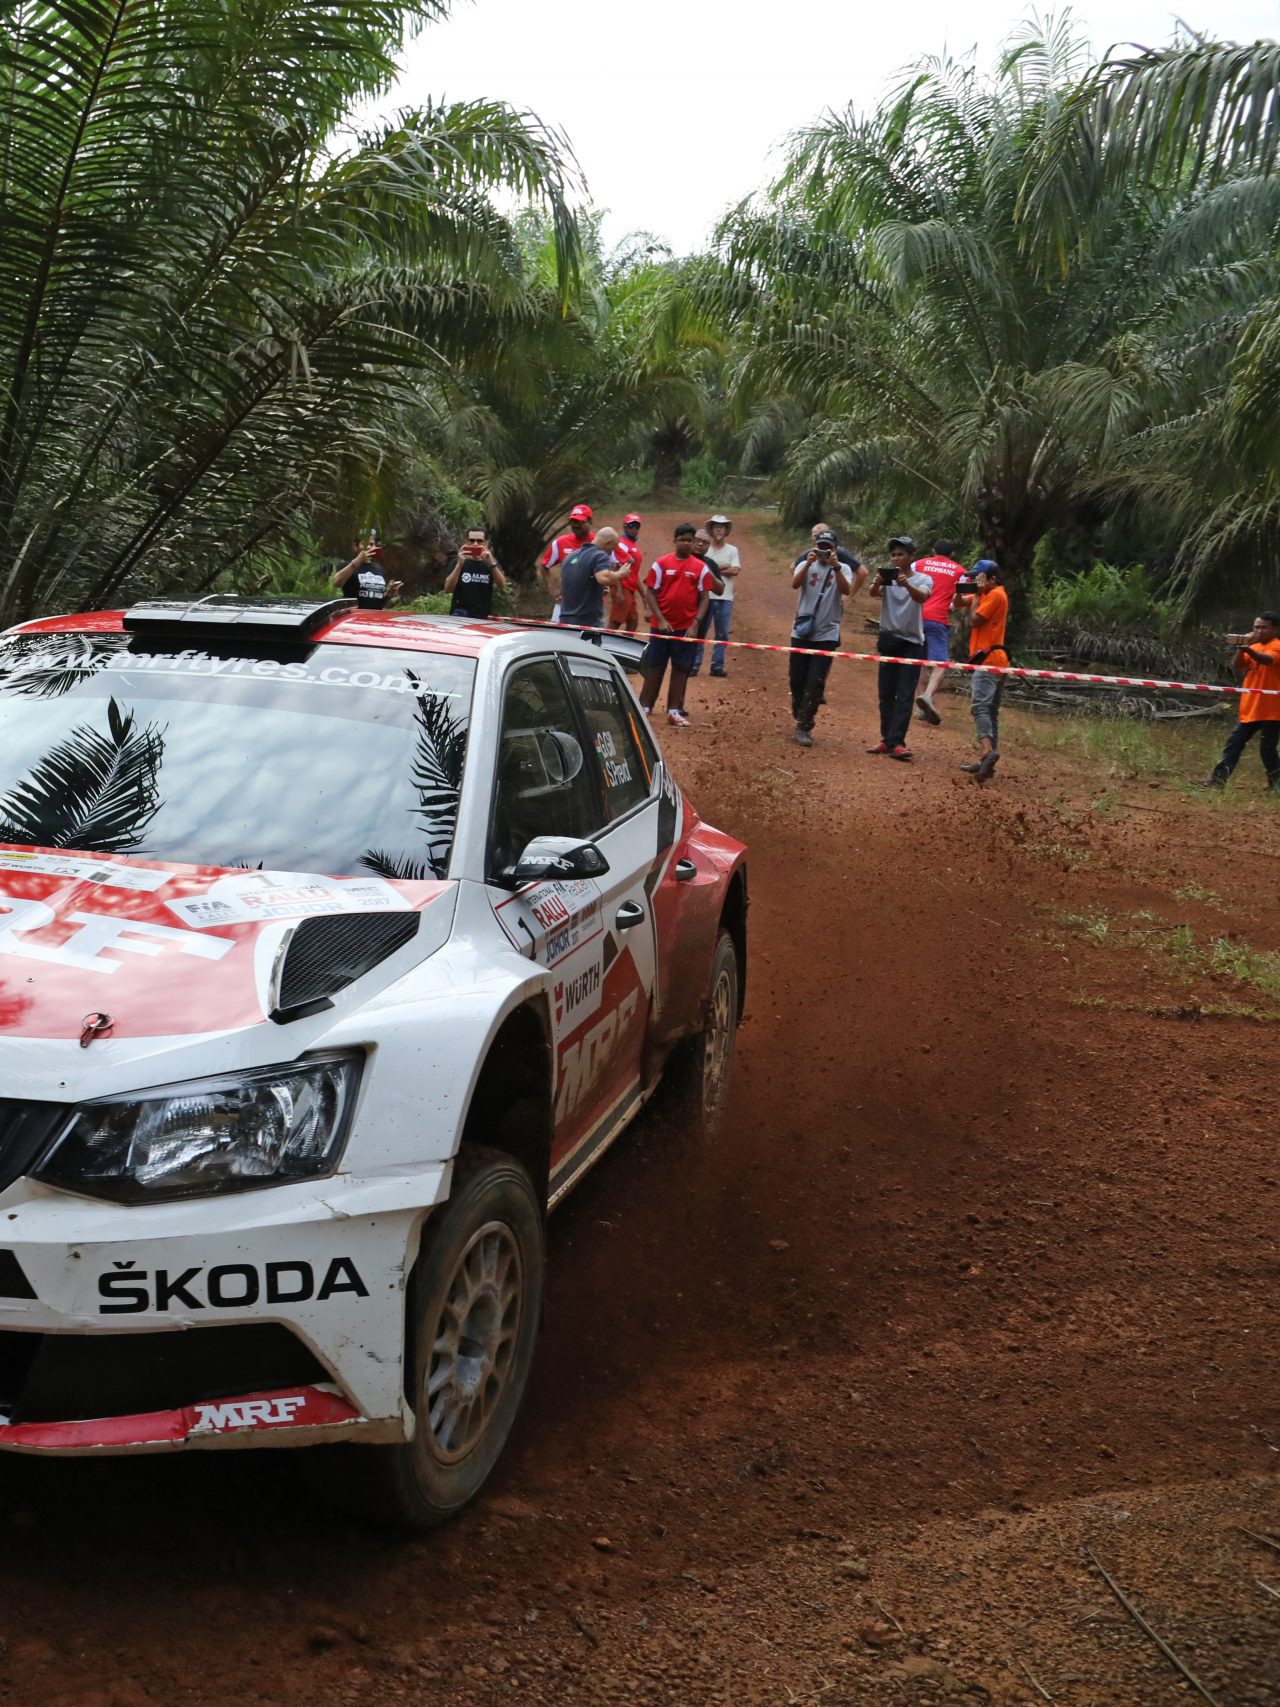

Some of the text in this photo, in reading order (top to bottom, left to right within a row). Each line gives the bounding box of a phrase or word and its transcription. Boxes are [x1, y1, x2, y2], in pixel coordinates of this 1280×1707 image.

[521, 856, 575, 871] MRF
[249, 874, 284, 889] 1
[260, 902, 346, 918] JOHOR
[356, 897, 391, 906] 2017
[518, 916, 536, 961] 1
[546, 928, 571, 964] JOHOR
[554, 986, 639, 1127] MRF
[98, 1256, 370, 1314] ŠKODA
[194, 1396, 306, 1430] MRF
